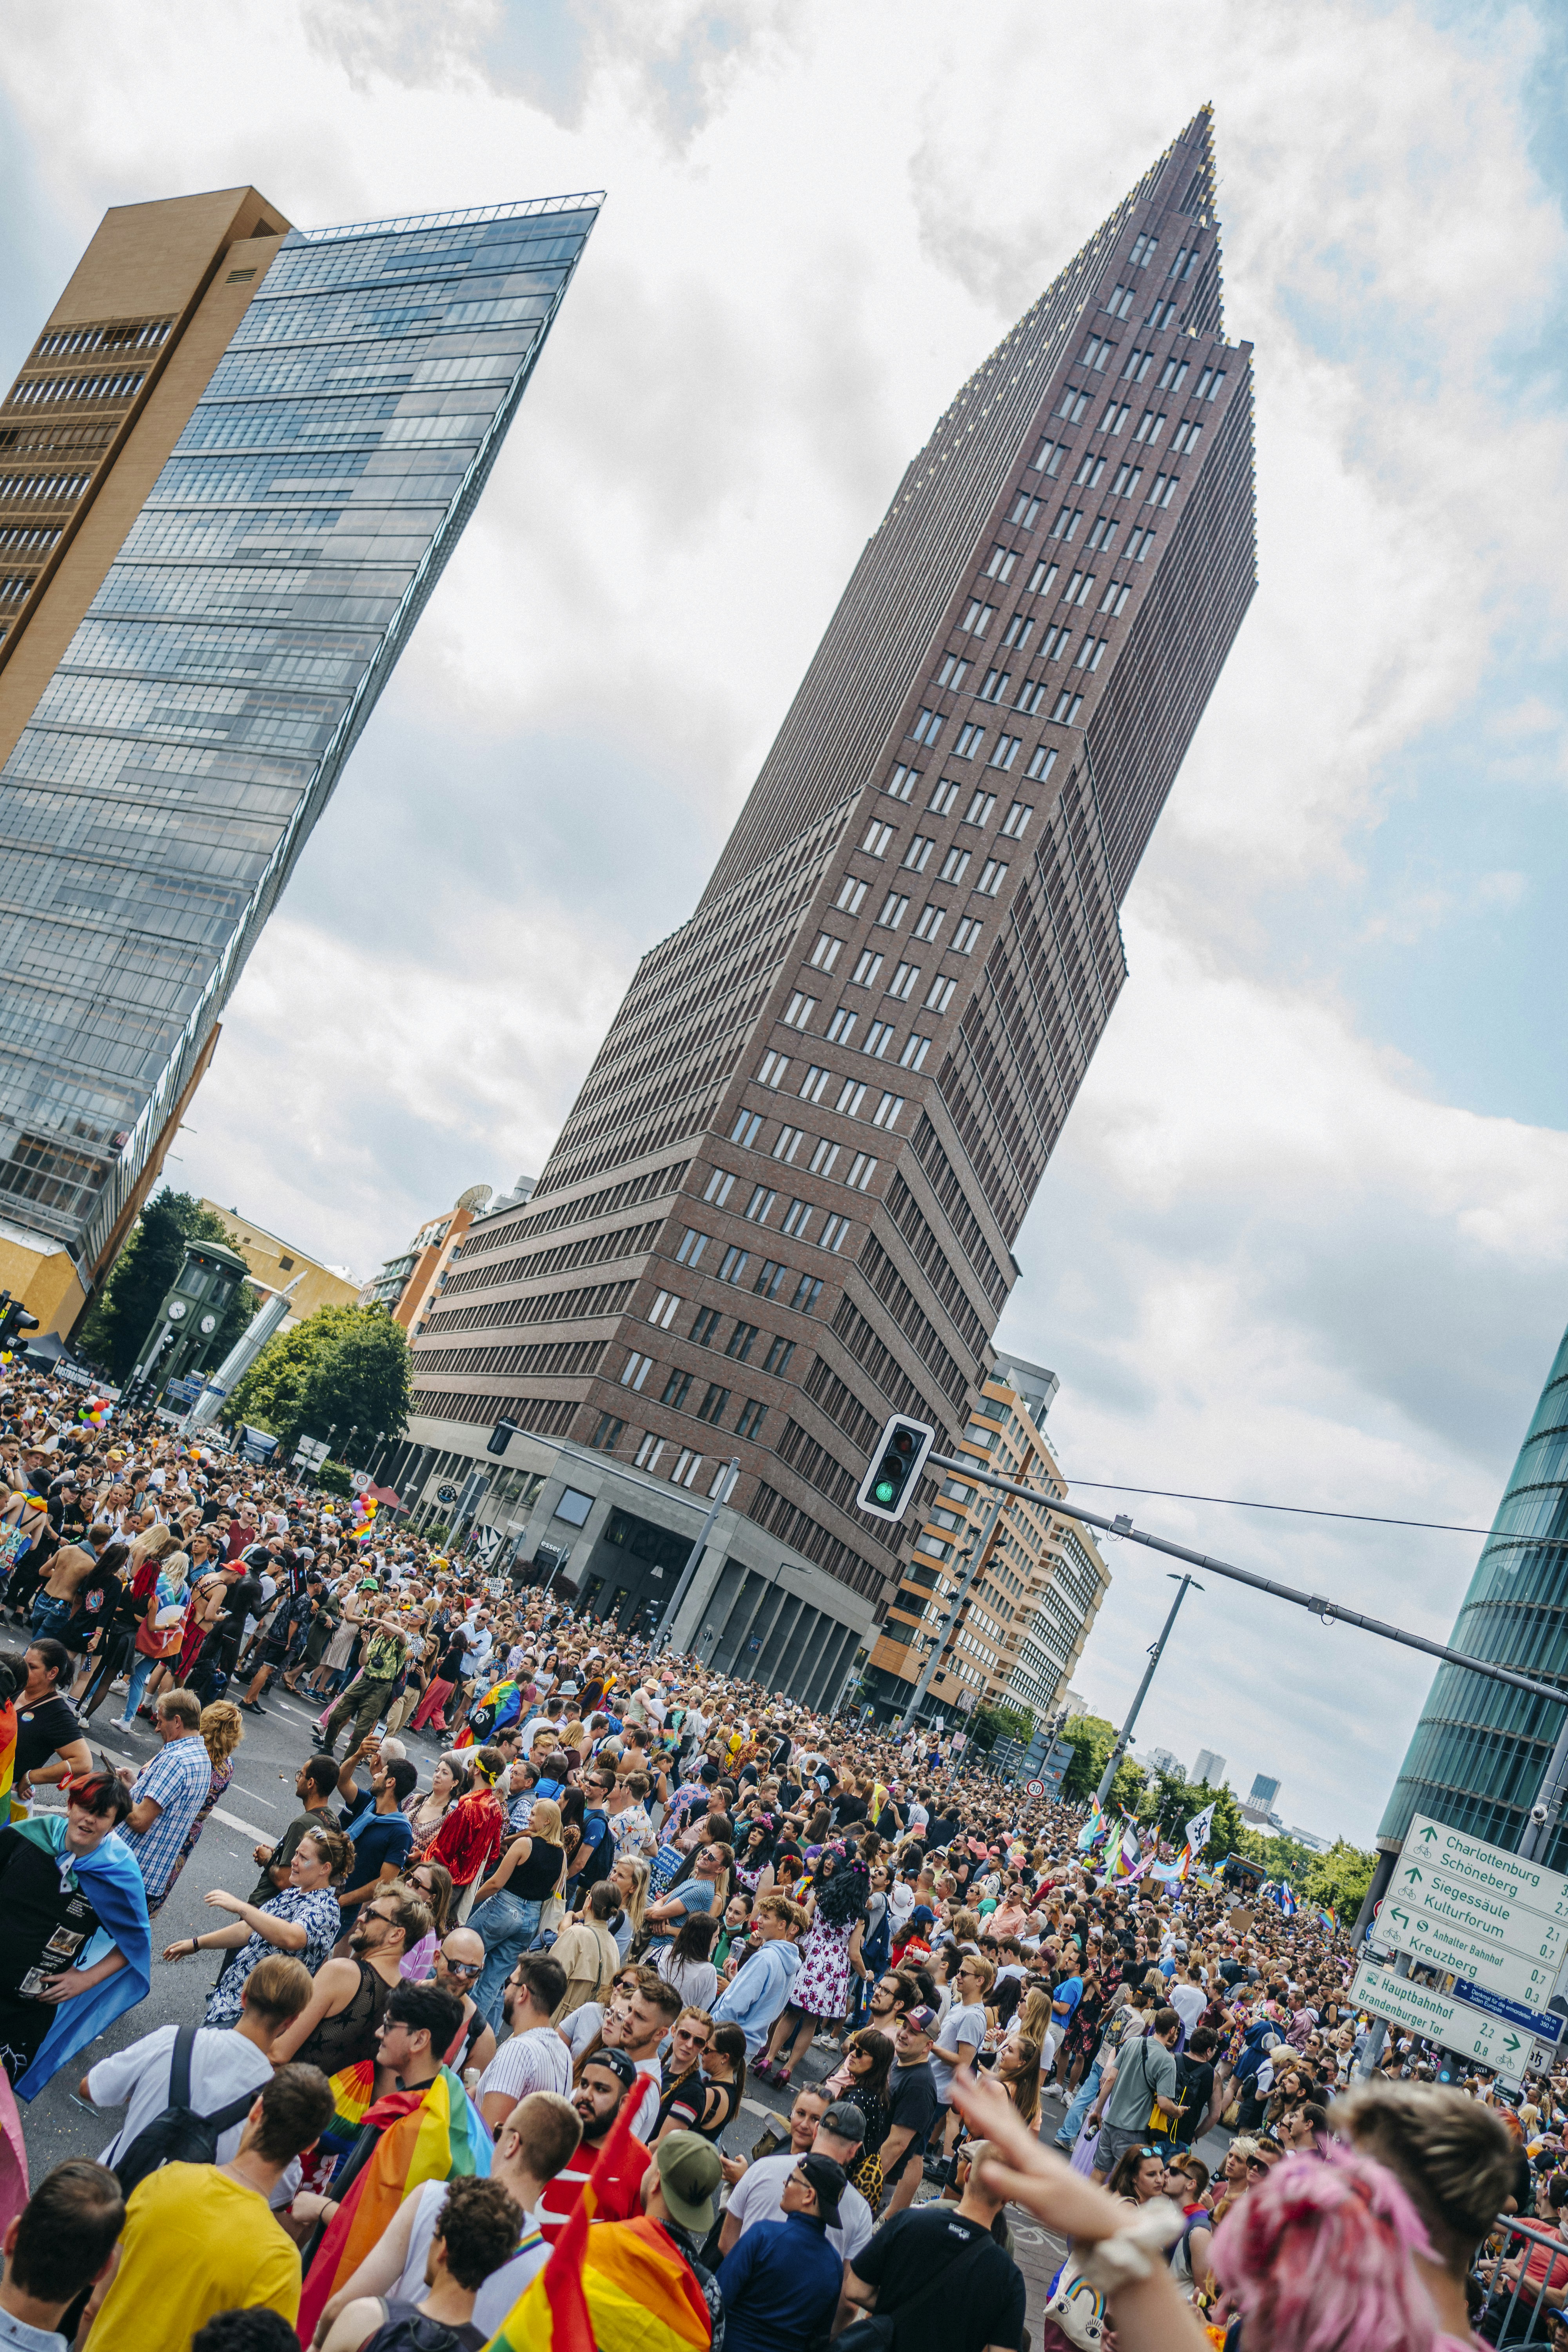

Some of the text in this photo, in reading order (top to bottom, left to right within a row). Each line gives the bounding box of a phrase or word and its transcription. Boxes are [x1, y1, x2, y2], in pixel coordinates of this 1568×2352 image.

[438, 1486, 455, 1500] PANORAMA
[1030, 1783, 1041, 1794] 30
[659, 1857, 671, 1867] großes
[1441, 1853, 1518, 1898] Schöneberg
[1446, 1836, 1540, 1887] Charlottenburg
[1431, 1877, 1510, 1920] Siegessäule
[1424, 1894, 1504, 1938] Kulturforum
[1364, 1954, 1384, 1966] Mauerweg
[1409, 1936, 1478, 1979] Kreuzberg
[1433, 1929, 1468, 1951] Anhalter
[1469, 1944, 1504, 1966] Bahnhof
[1359, 1989, 1444, 2035] Brandenburger Tor
[1382, 1978, 1454, 2020] Hauptbahnhof
[1470, 1996, 1503, 2013] Juden Europas
[1471, 1989, 1491, 2001] Denkmal
[1506, 2005, 1531, 2020] ermordeten
[1540, 2020, 1549, 2029] 350
[1494, 2089, 1515, 2103] Mauerweg
